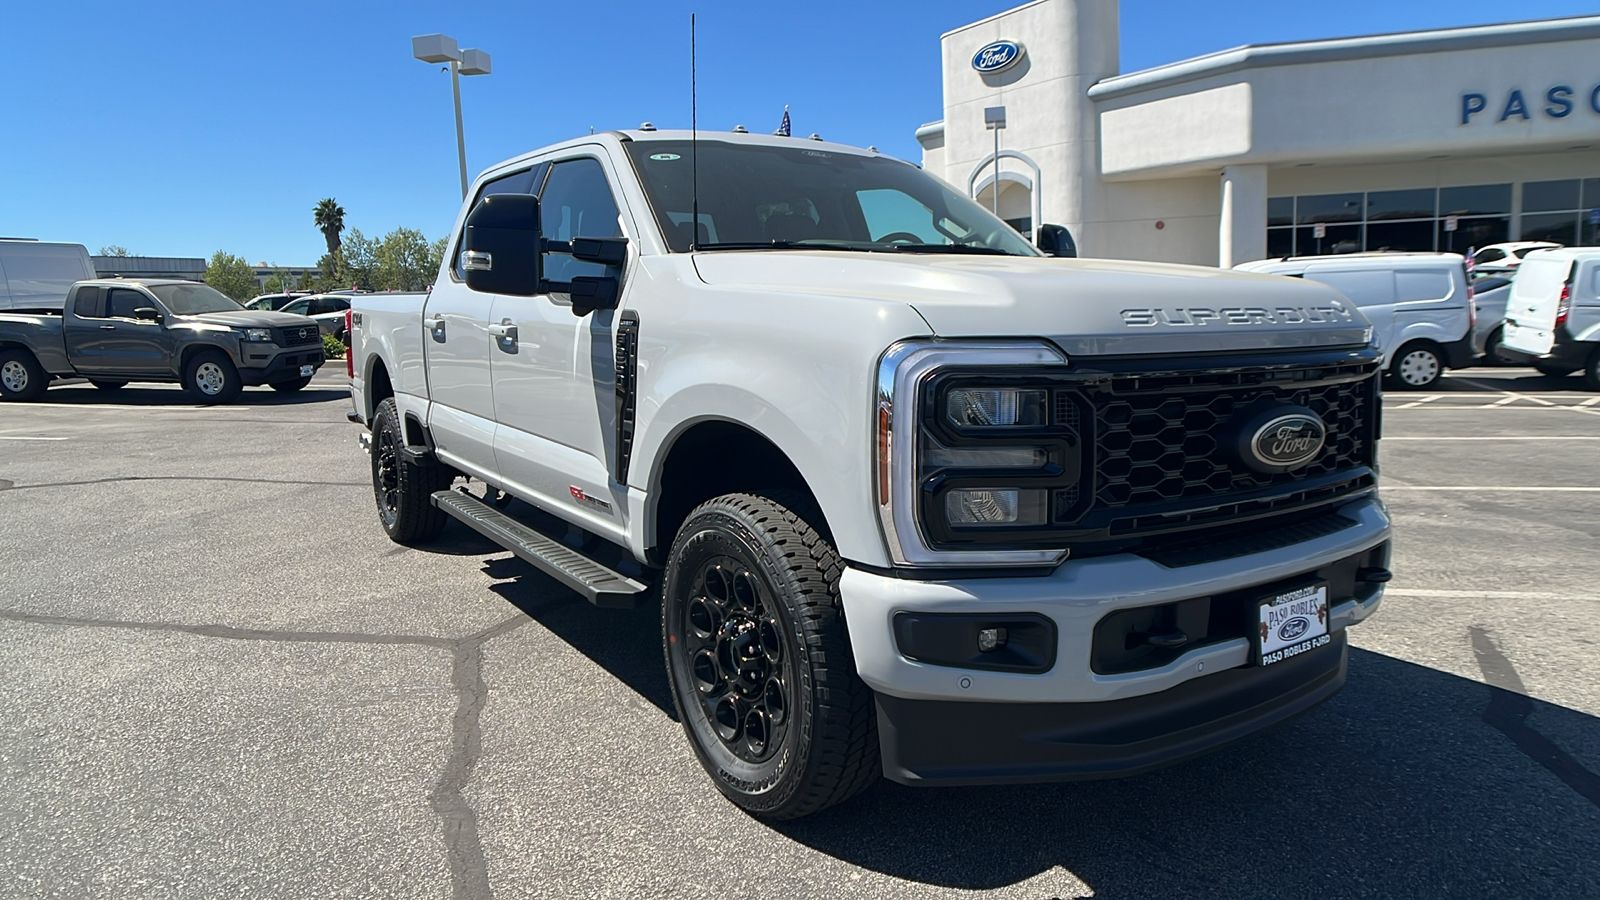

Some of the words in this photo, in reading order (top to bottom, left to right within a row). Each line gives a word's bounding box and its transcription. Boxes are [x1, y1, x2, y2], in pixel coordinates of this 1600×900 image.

[980, 45, 1009, 68] Ford
[1272, 422, 1312, 455] Ford
[1269, 607, 1288, 630] PASO
[1290, 598, 1318, 616] ROBLES
[1284, 620, 1305, 638] Ford
[1262, 651, 1283, 666] PASO
[1283, 641, 1311, 658] ROBLES
